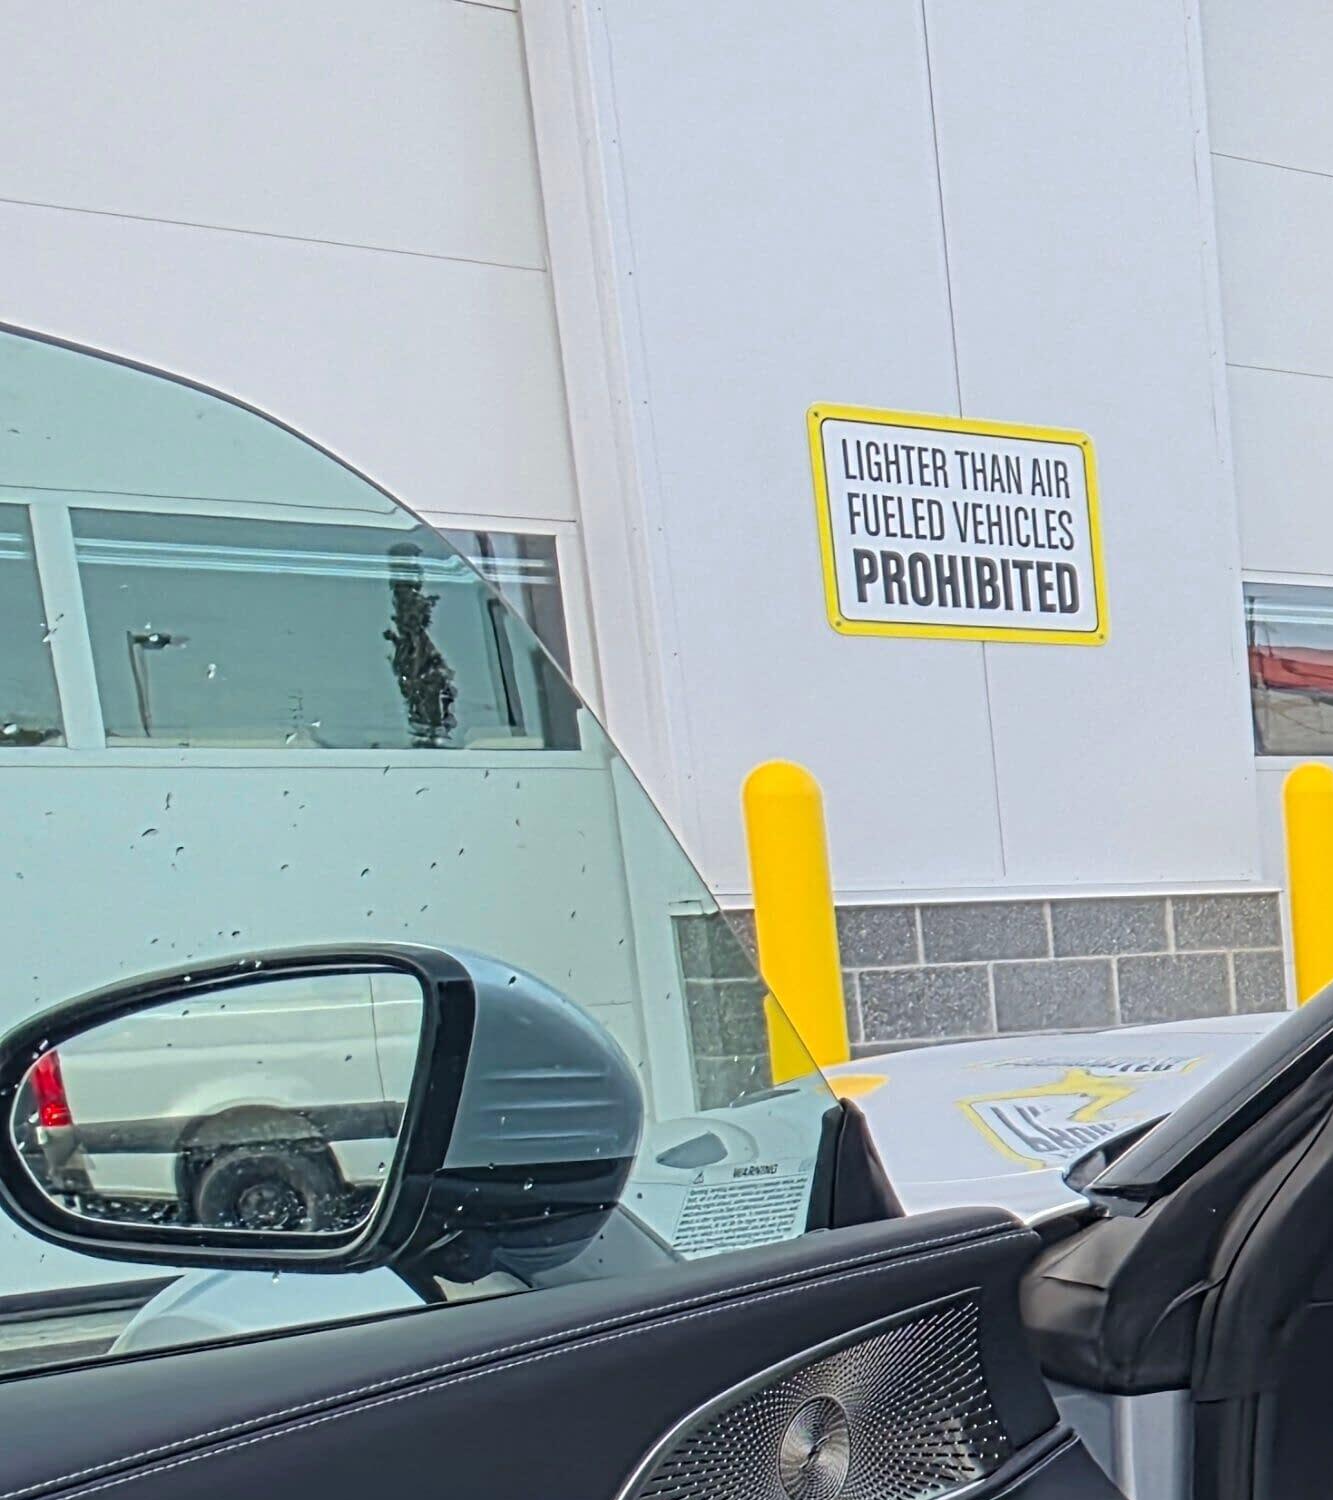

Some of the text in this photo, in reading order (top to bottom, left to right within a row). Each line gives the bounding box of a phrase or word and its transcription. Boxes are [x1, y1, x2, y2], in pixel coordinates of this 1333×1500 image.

[842, 438, 1070, 498] LIGHTER THAN AIR
[847, 492, 1075, 551] FUELED VEHICLES
[852, 547, 1080, 614] PROHIBITED
[732, 1163, 779, 1178] WARNING
